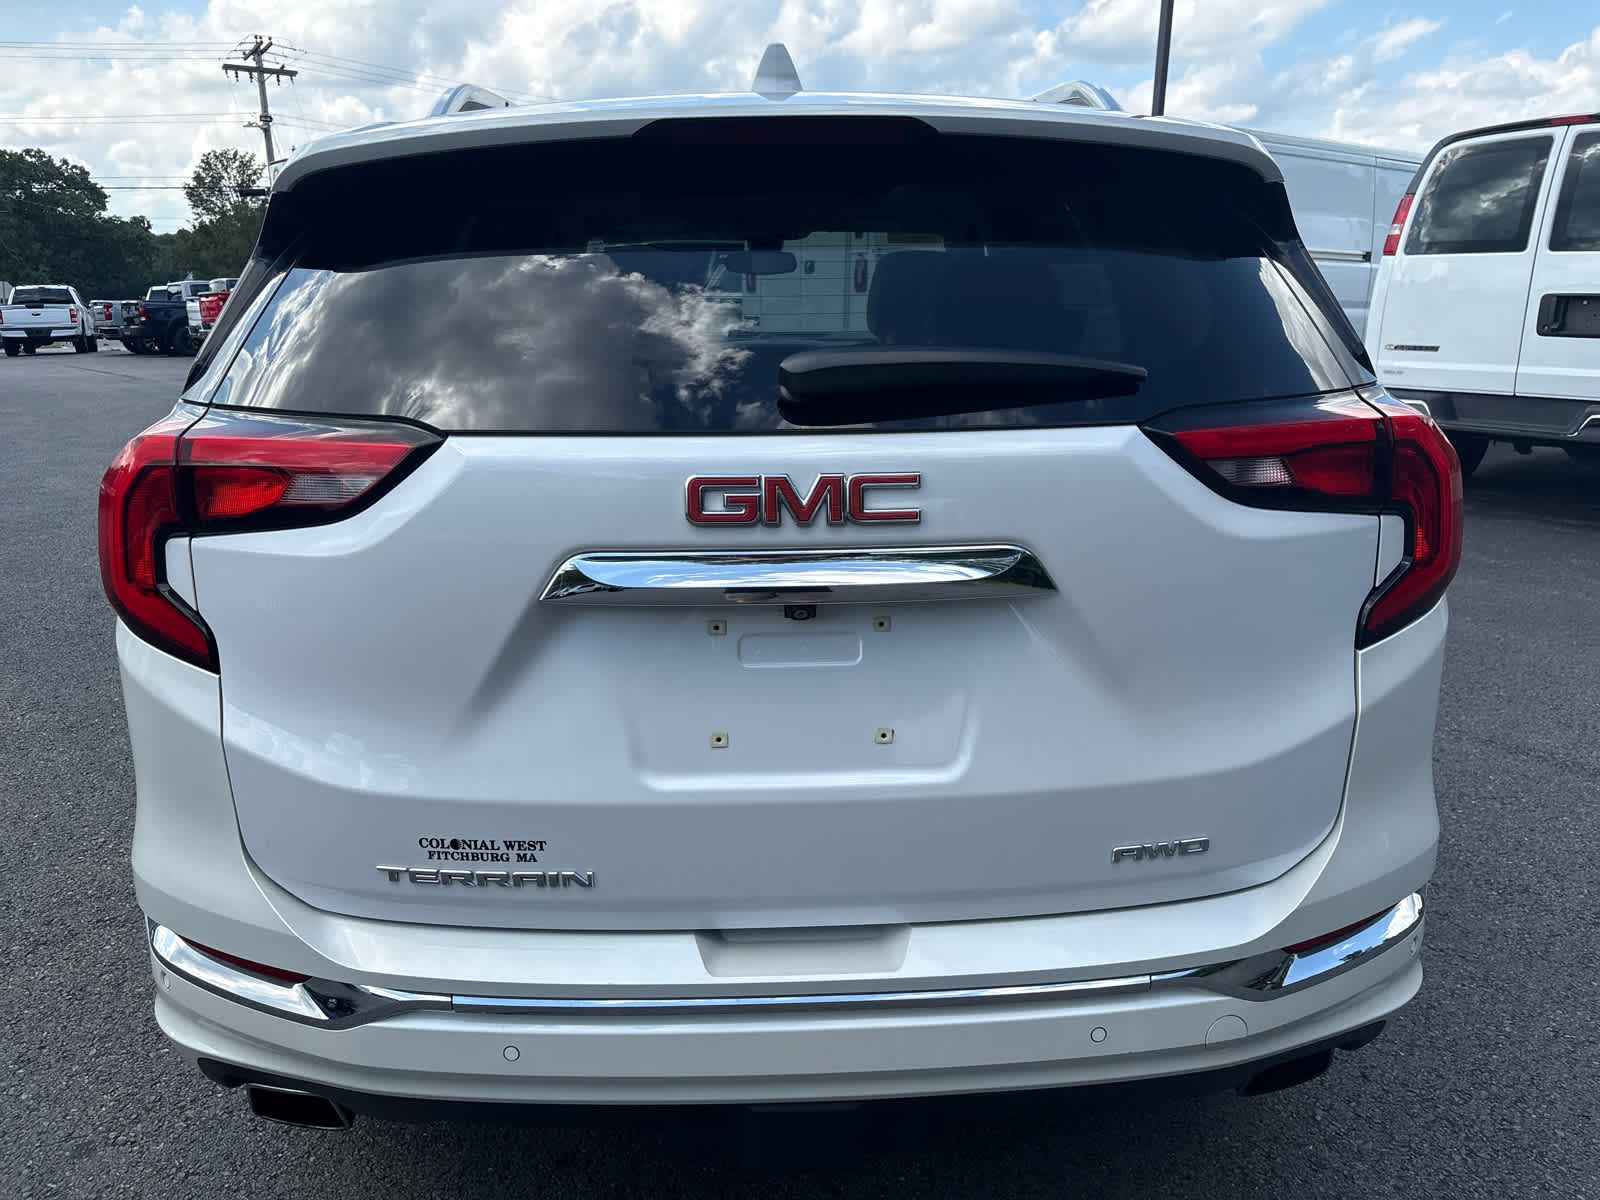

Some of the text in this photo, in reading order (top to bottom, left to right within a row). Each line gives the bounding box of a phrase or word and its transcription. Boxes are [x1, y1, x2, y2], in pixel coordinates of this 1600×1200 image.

[685, 472, 921, 527] GMC
[427, 850, 538, 863] FITCHBURG MA
[503, 840, 547, 852] WEST
[1111, 837, 1210, 864] AWD
[376, 865, 595, 888] TERRAIN
